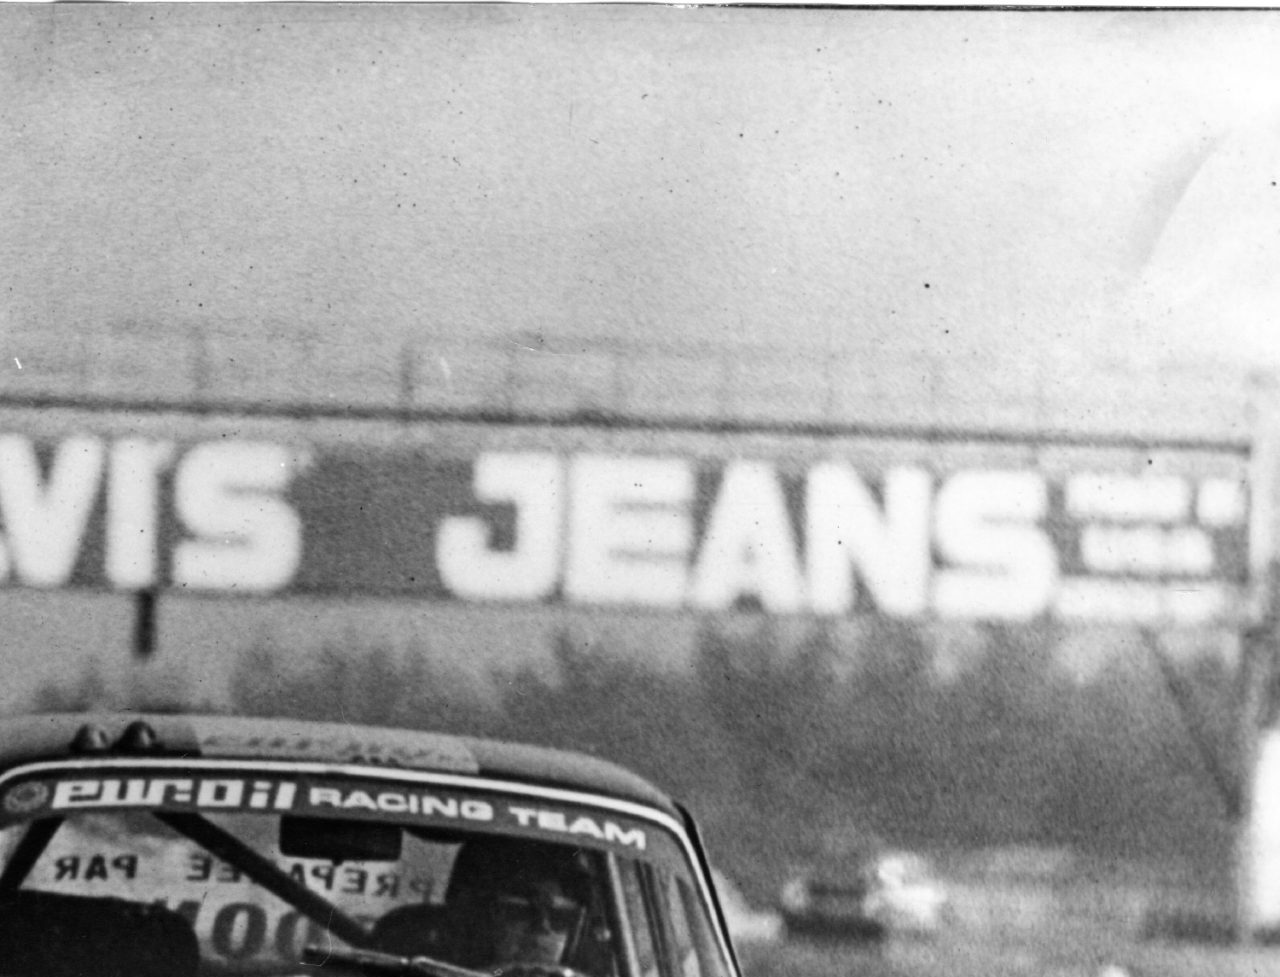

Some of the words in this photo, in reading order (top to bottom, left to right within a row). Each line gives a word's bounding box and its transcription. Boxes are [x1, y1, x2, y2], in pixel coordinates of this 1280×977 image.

[435, 452, 1060, 622] JEANS
[310, 787, 494, 822] RACING
[509, 806, 646, 850] TEAM
